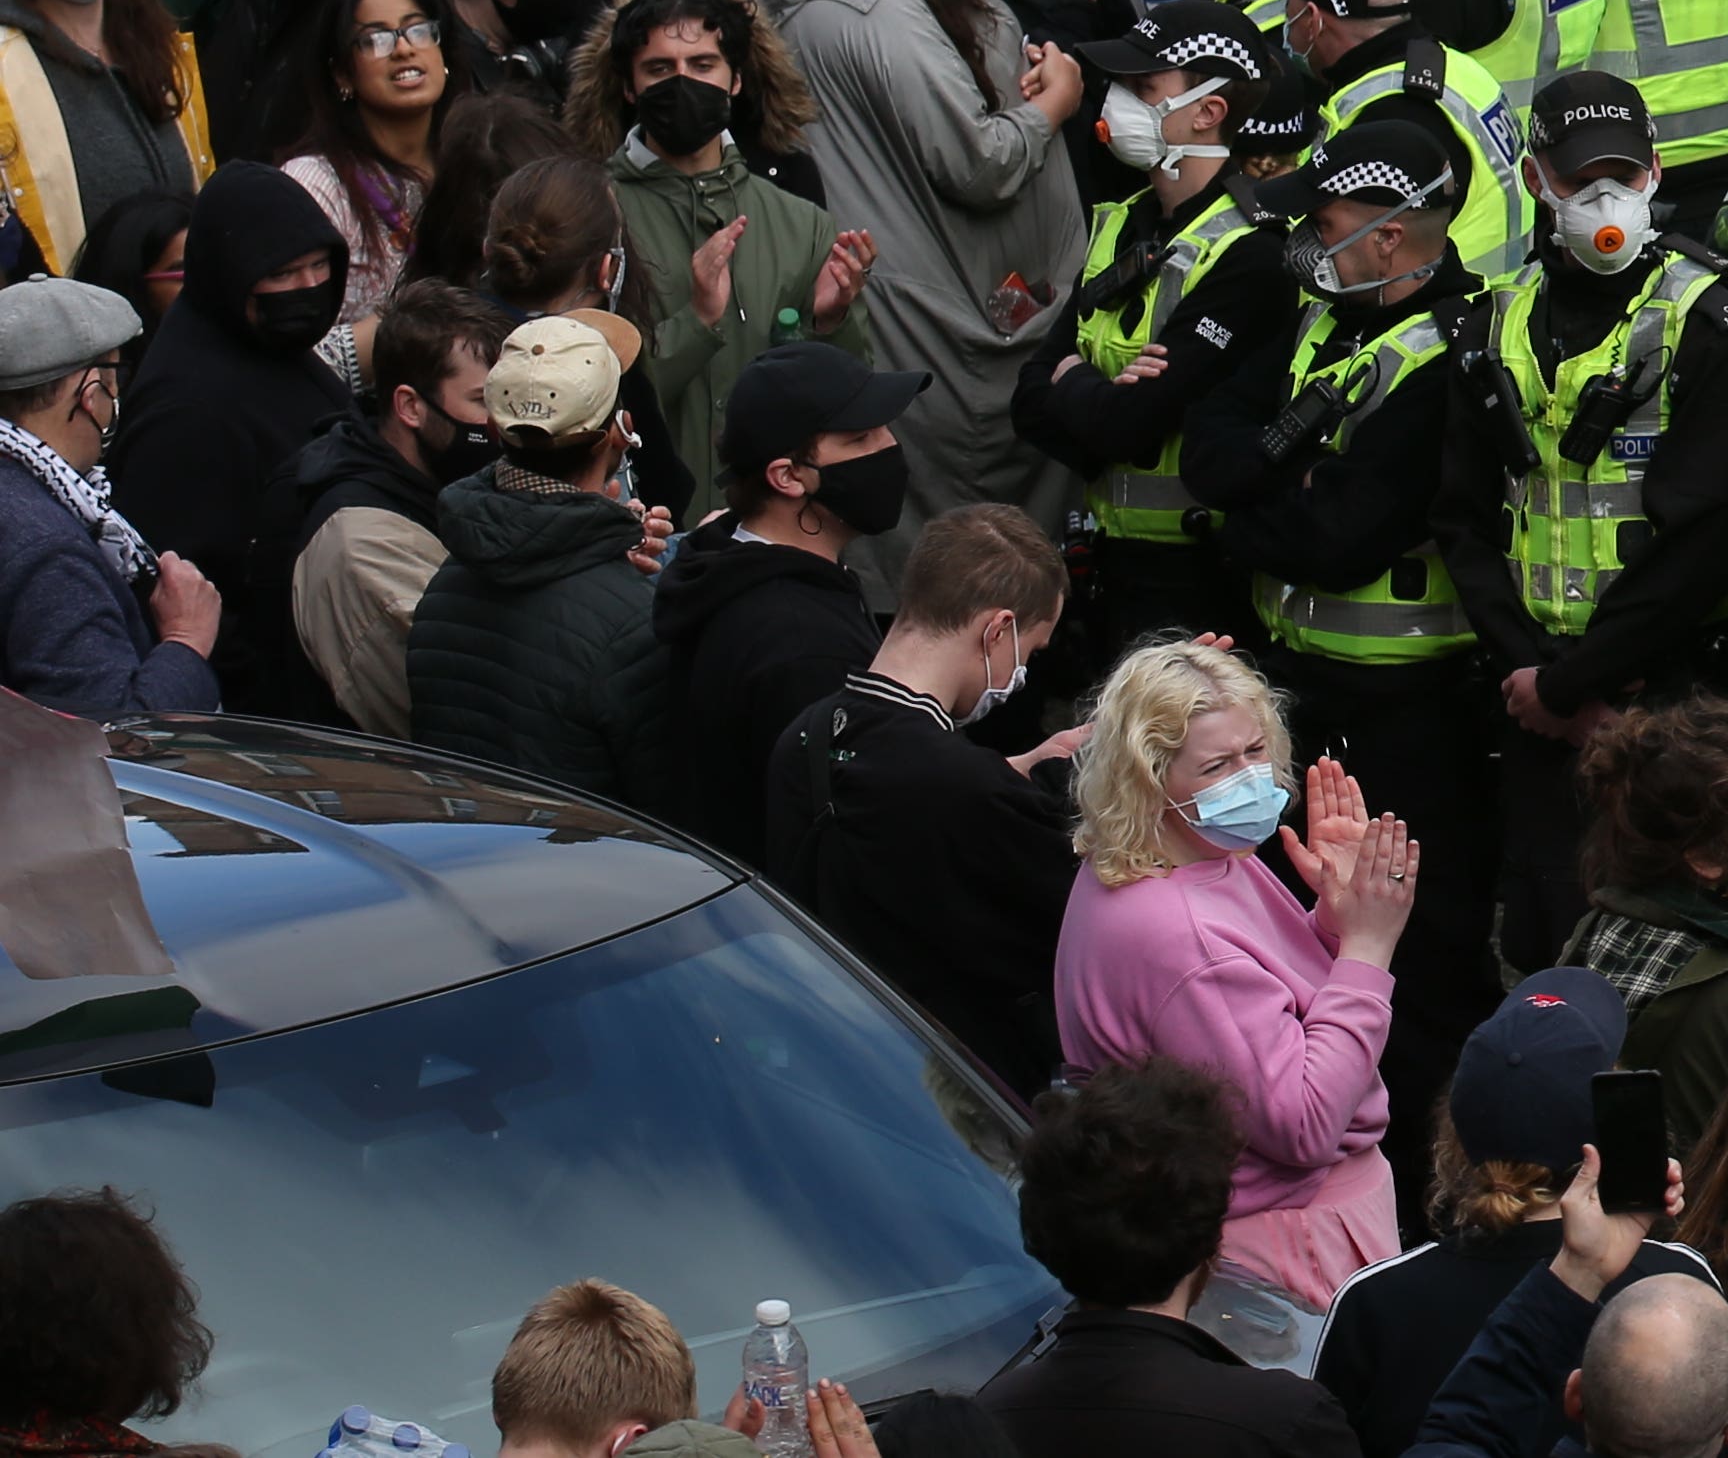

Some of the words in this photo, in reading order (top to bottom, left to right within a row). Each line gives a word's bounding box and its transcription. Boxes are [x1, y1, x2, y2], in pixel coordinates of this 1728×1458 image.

[1563, 104, 1632, 125] POLICE
[1195, 323, 1228, 350] SCOTLAND
[1200, 316, 1233, 341] POLICE
[508, 400, 558, 420] Lynx
[1613, 439, 1655, 456] POLI
